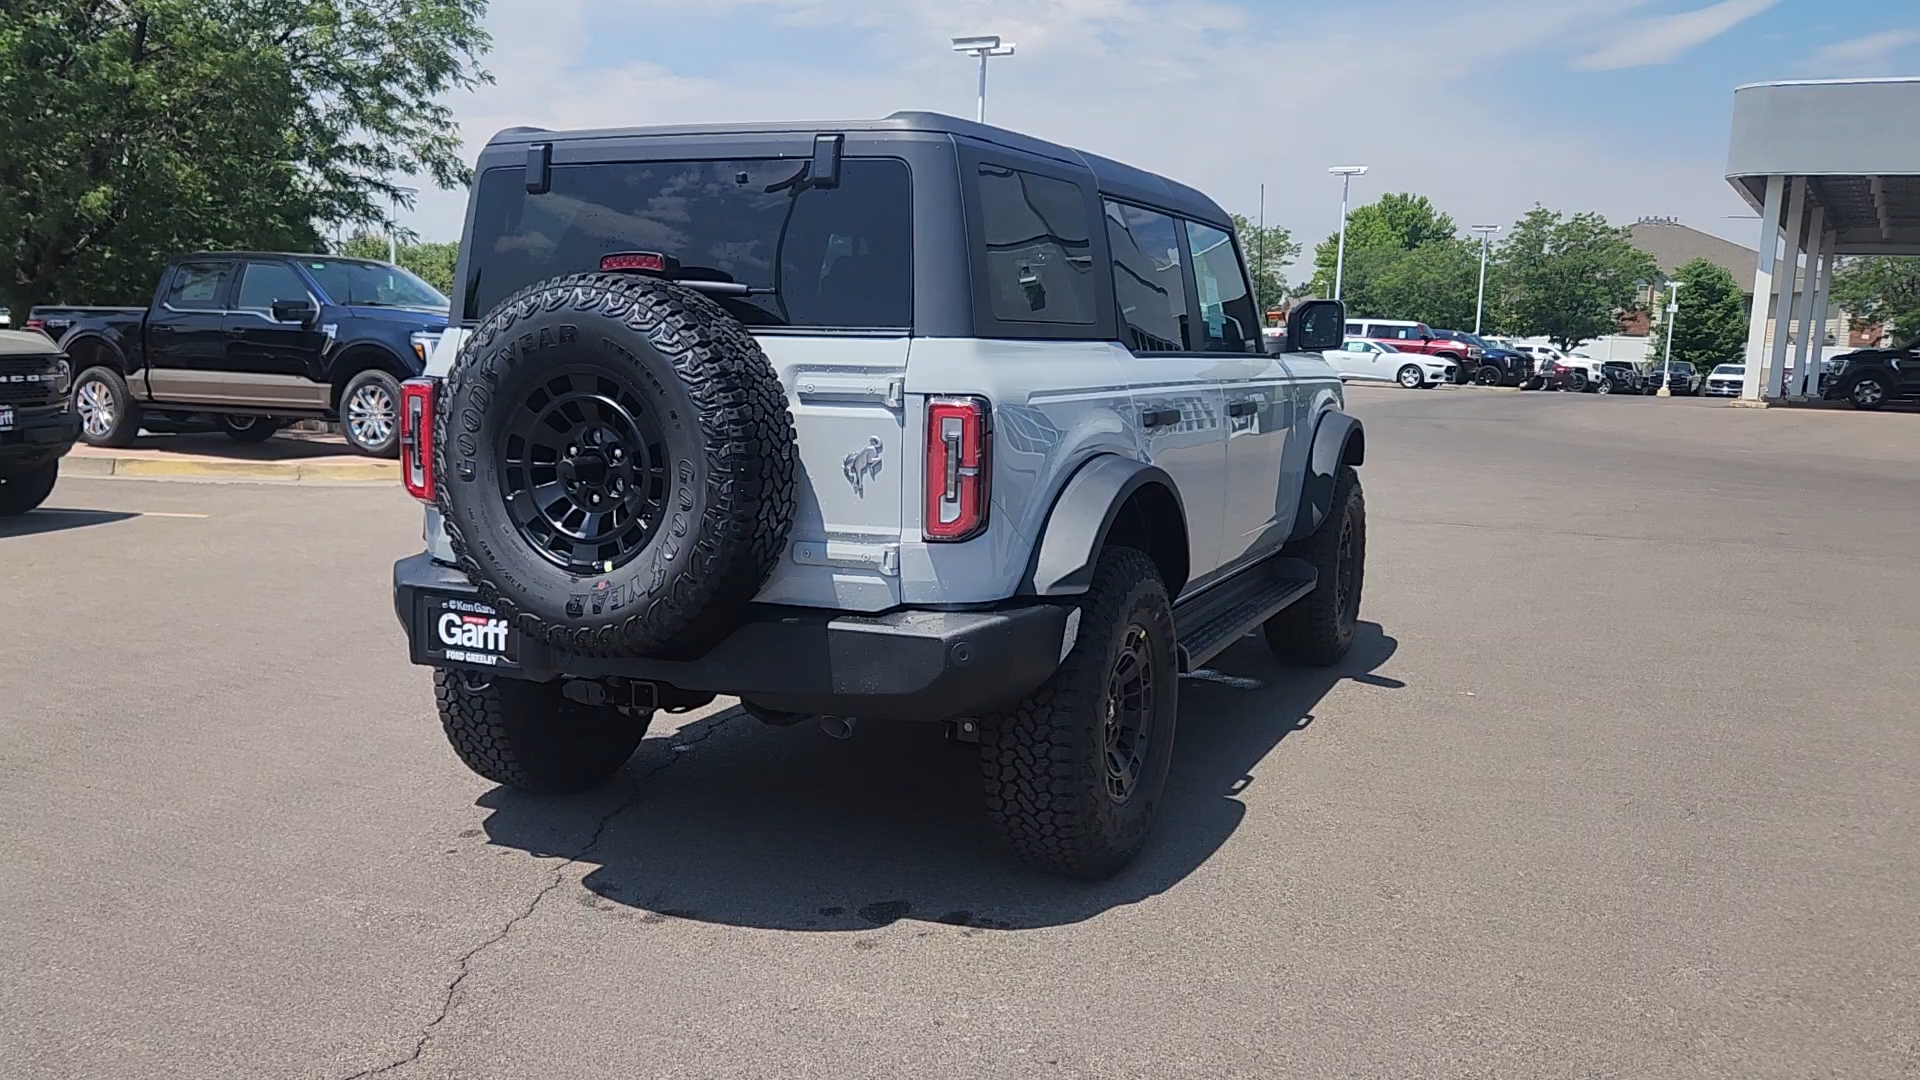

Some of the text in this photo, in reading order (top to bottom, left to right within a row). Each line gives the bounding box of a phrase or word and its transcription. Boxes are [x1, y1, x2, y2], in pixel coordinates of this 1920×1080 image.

[438, 612, 508, 651] Garff
[446, 650, 497, 665] FORD GREELEY
